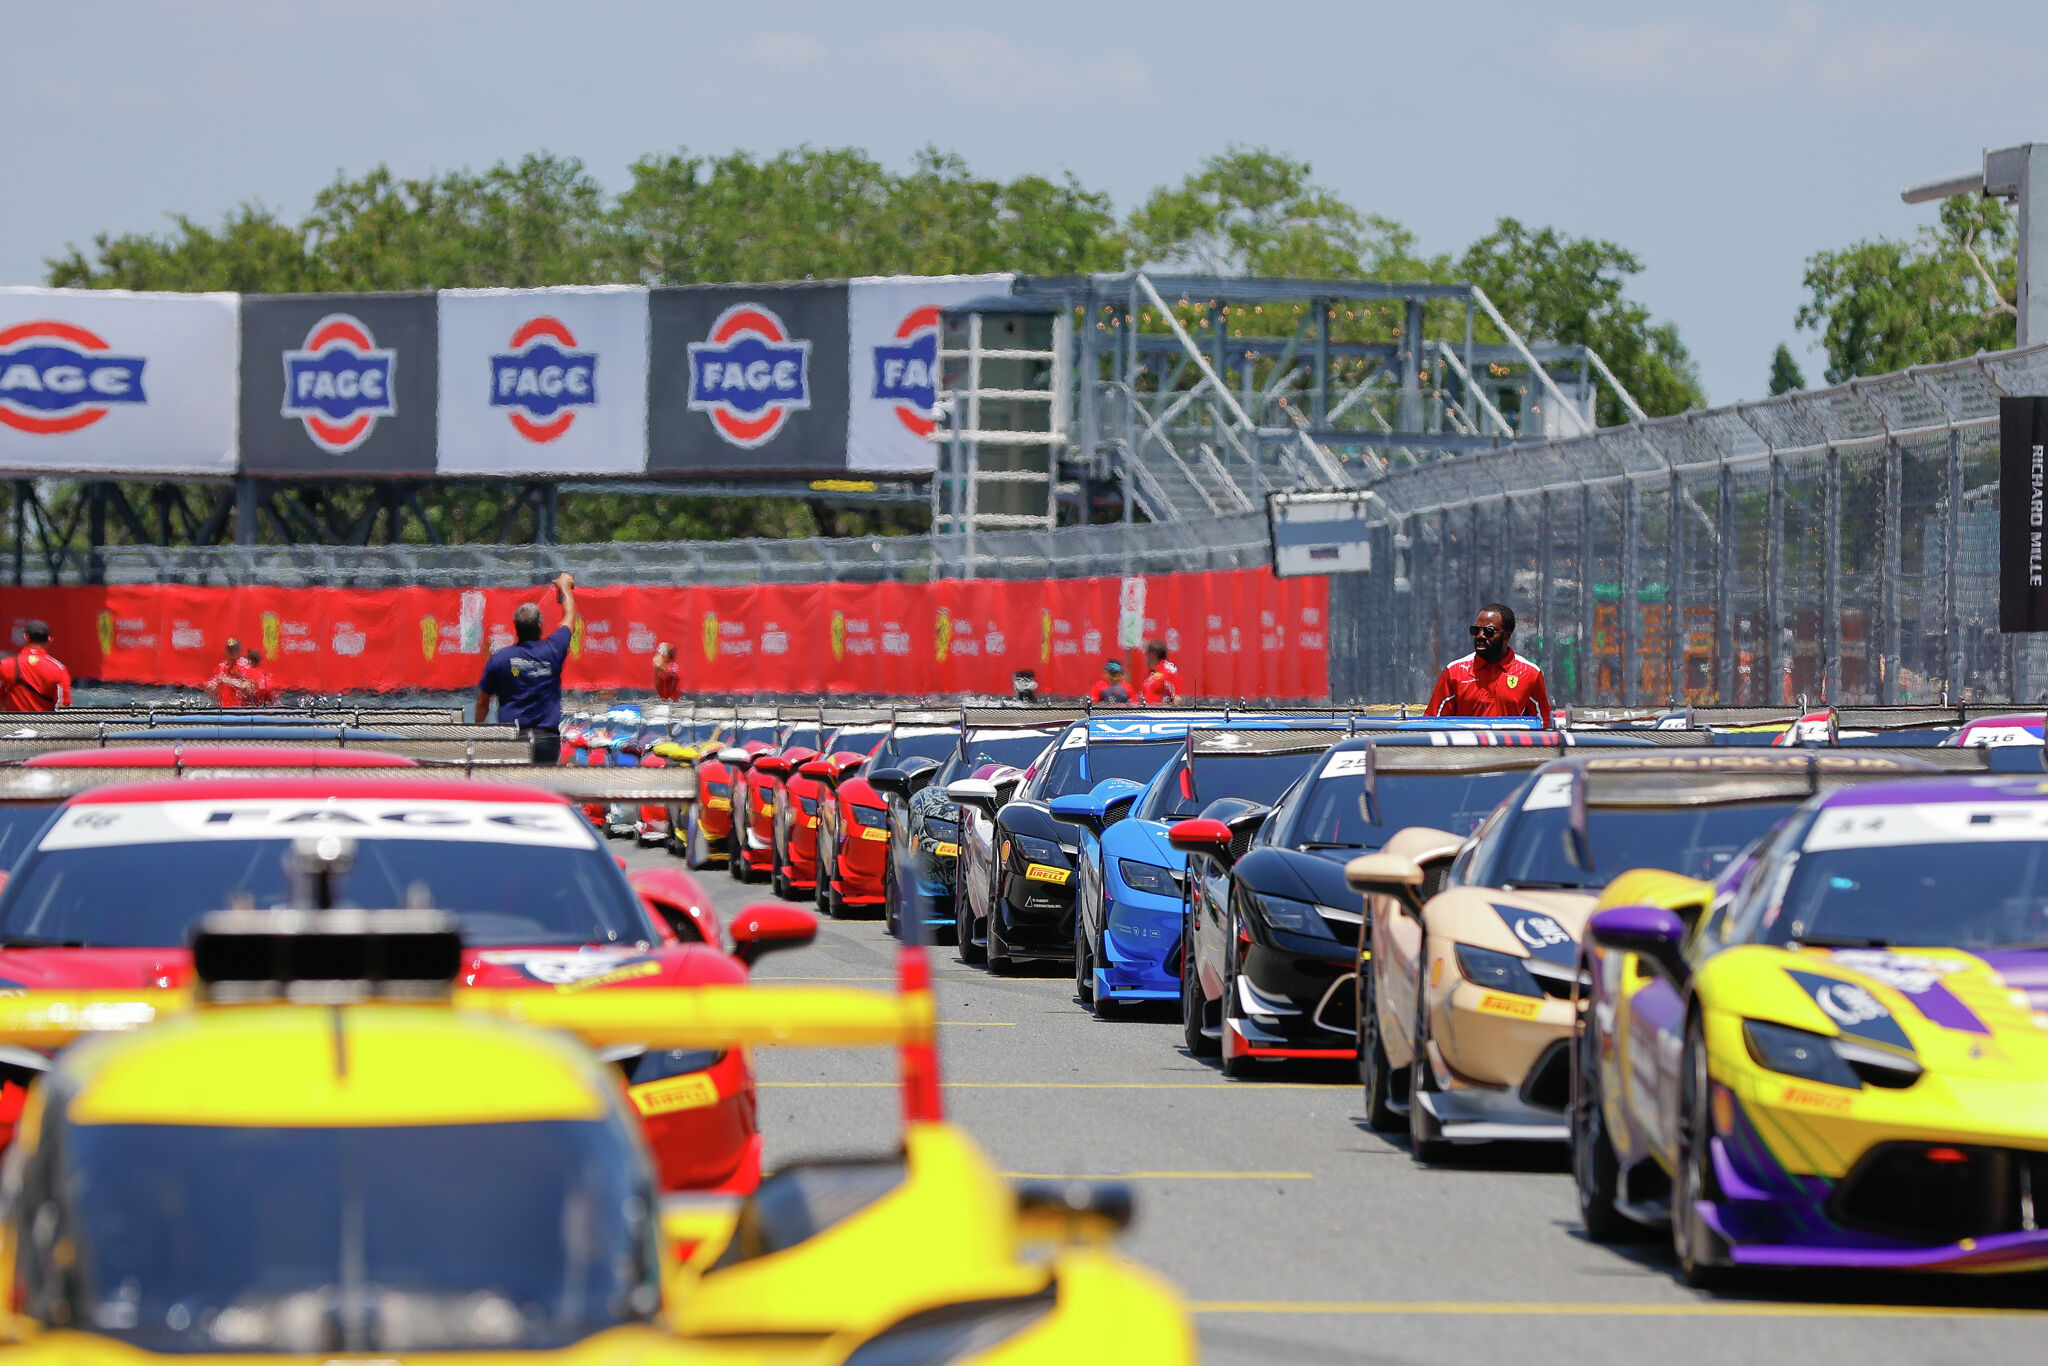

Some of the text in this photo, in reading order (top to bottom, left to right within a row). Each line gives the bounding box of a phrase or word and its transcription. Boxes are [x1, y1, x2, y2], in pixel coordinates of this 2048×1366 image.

[0, 363, 132, 395] AGE
[297, 368, 385, 400] FAGE
[498, 365, 590, 398] FAGE
[703, 360, 798, 391] FAGE
[883, 358, 936, 389] FA
[2029, 445, 2044, 586] RICHARD MILLE
[1029, 866, 1065, 881] PIRELLI
[1483, 996, 1537, 1017] PIRELLI
